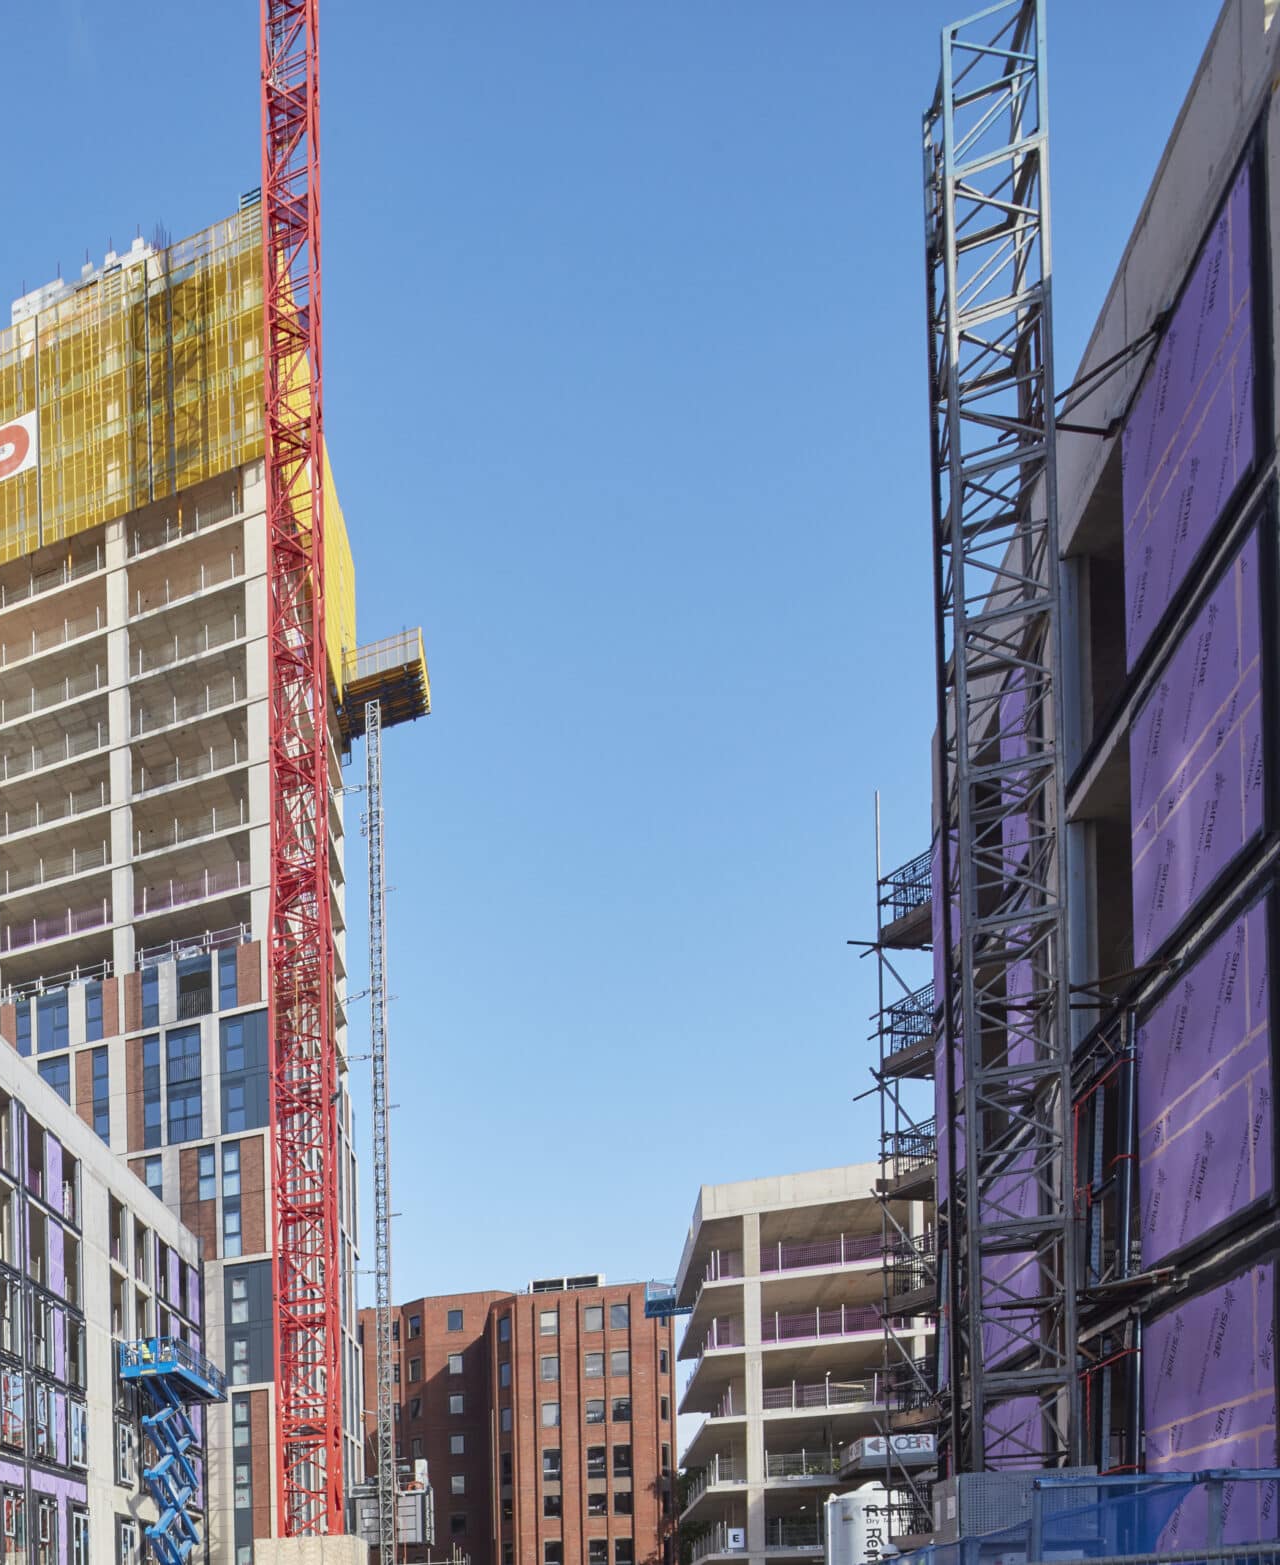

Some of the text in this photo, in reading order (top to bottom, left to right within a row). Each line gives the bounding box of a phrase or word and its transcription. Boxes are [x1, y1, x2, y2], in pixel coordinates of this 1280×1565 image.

[1179, 485, 1194, 543] siniat
[1197, 631, 1213, 688] siniat
[1204, 799, 1218, 852] siniat
[1157, 863, 1170, 911] siniat
[1223, 951, 1241, 1006] siniat
[1174, 1005, 1189, 1054] siniat
[1194, 1155, 1208, 1203] siniat
[1148, 1191, 1162, 1233] siniat
[1165, 1336, 1180, 1378] siniat
[1213, 1311, 1228, 1360] siniat
[732, 1534, 741, 1543] E
